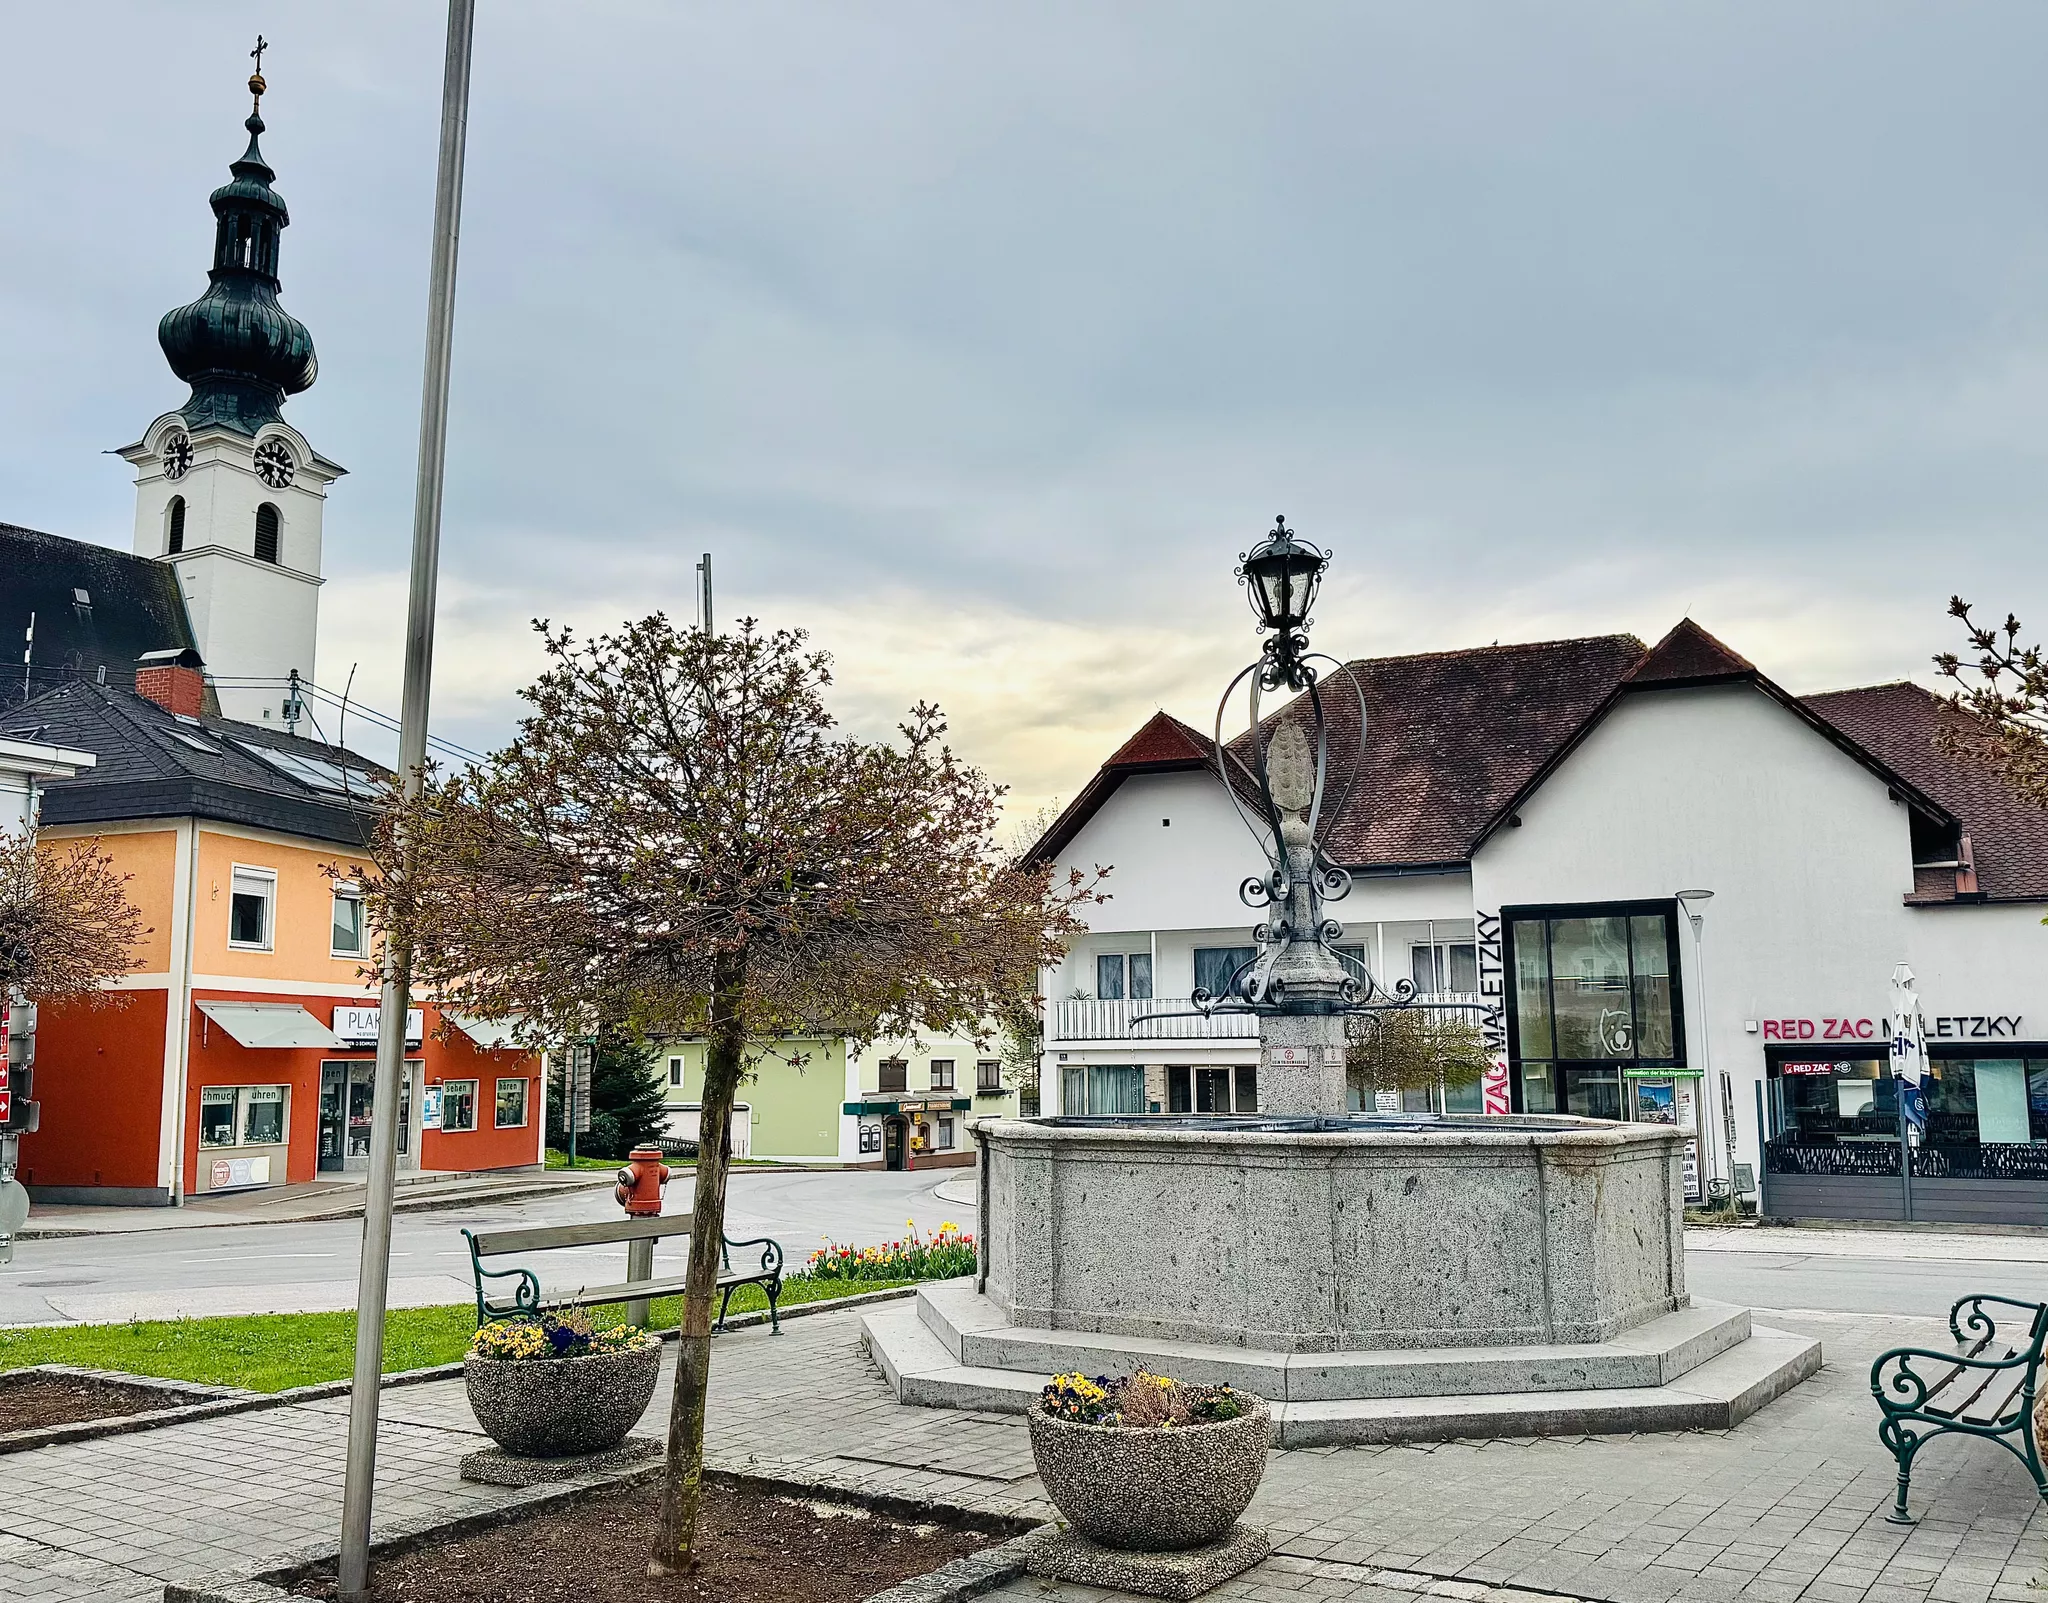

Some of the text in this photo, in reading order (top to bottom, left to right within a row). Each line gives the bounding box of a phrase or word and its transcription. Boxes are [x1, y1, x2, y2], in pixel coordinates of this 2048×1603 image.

[1763, 1019, 1815, 1039] RED
[1823, 1018, 1873, 1039] ZAC
[1882, 1016, 2022, 1038] MLETZKY
[1793, 1064, 1811, 1073] RED
[1812, 1063, 1830, 1072] ZAC
[251, 1088, 276, 1100] uhren
[446, 1083, 467, 1093] sehen
[202, 1089, 237, 1101] chmuck
